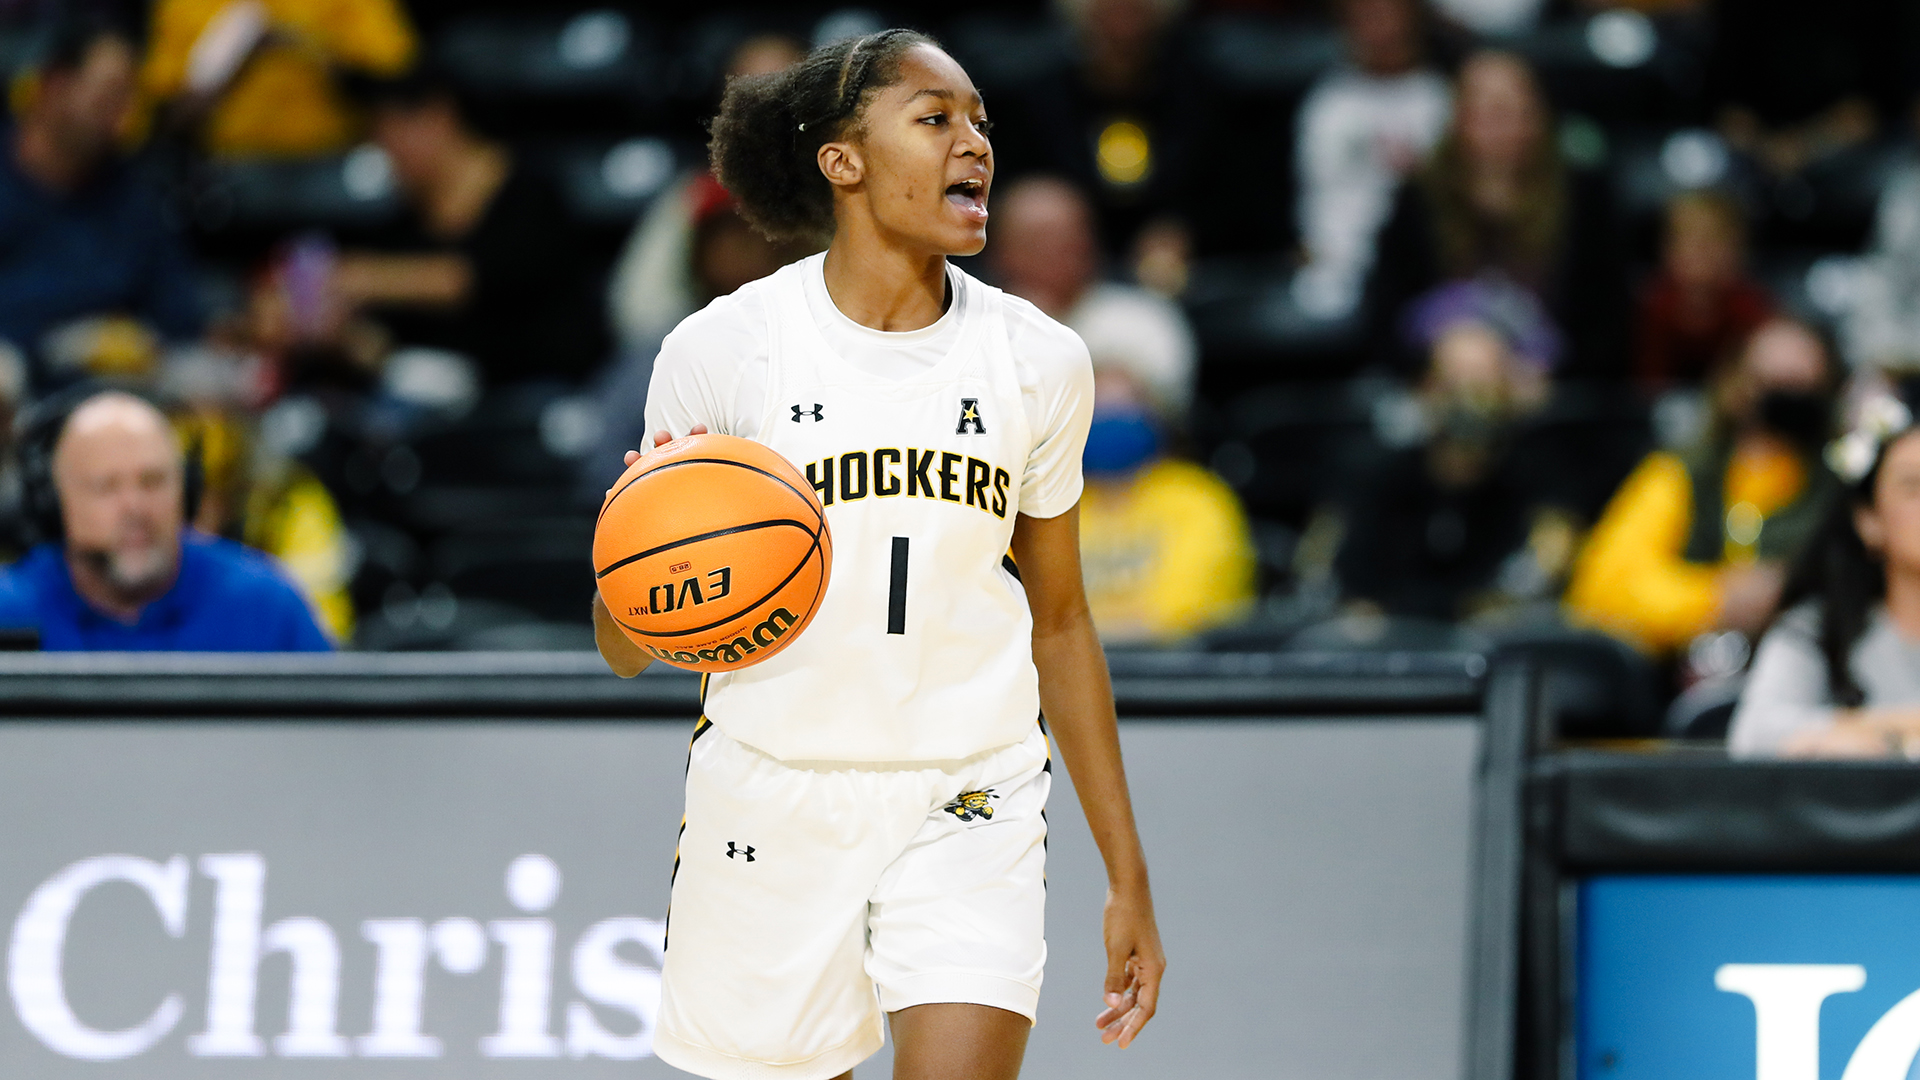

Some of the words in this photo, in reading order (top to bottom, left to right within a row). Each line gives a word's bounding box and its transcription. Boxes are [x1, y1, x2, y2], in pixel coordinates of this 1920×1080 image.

[956, 398, 987, 435] A
[805, 447, 1011, 521] HOCKERS
[649, 566, 732, 615] EVO
[887, 536, 909, 635] 1
[628, 605, 649, 616] NXT
[696, 640, 718, 648] GAME
[720, 626, 748, 641] INDOOR
[6, 852, 666, 1061] Chris
